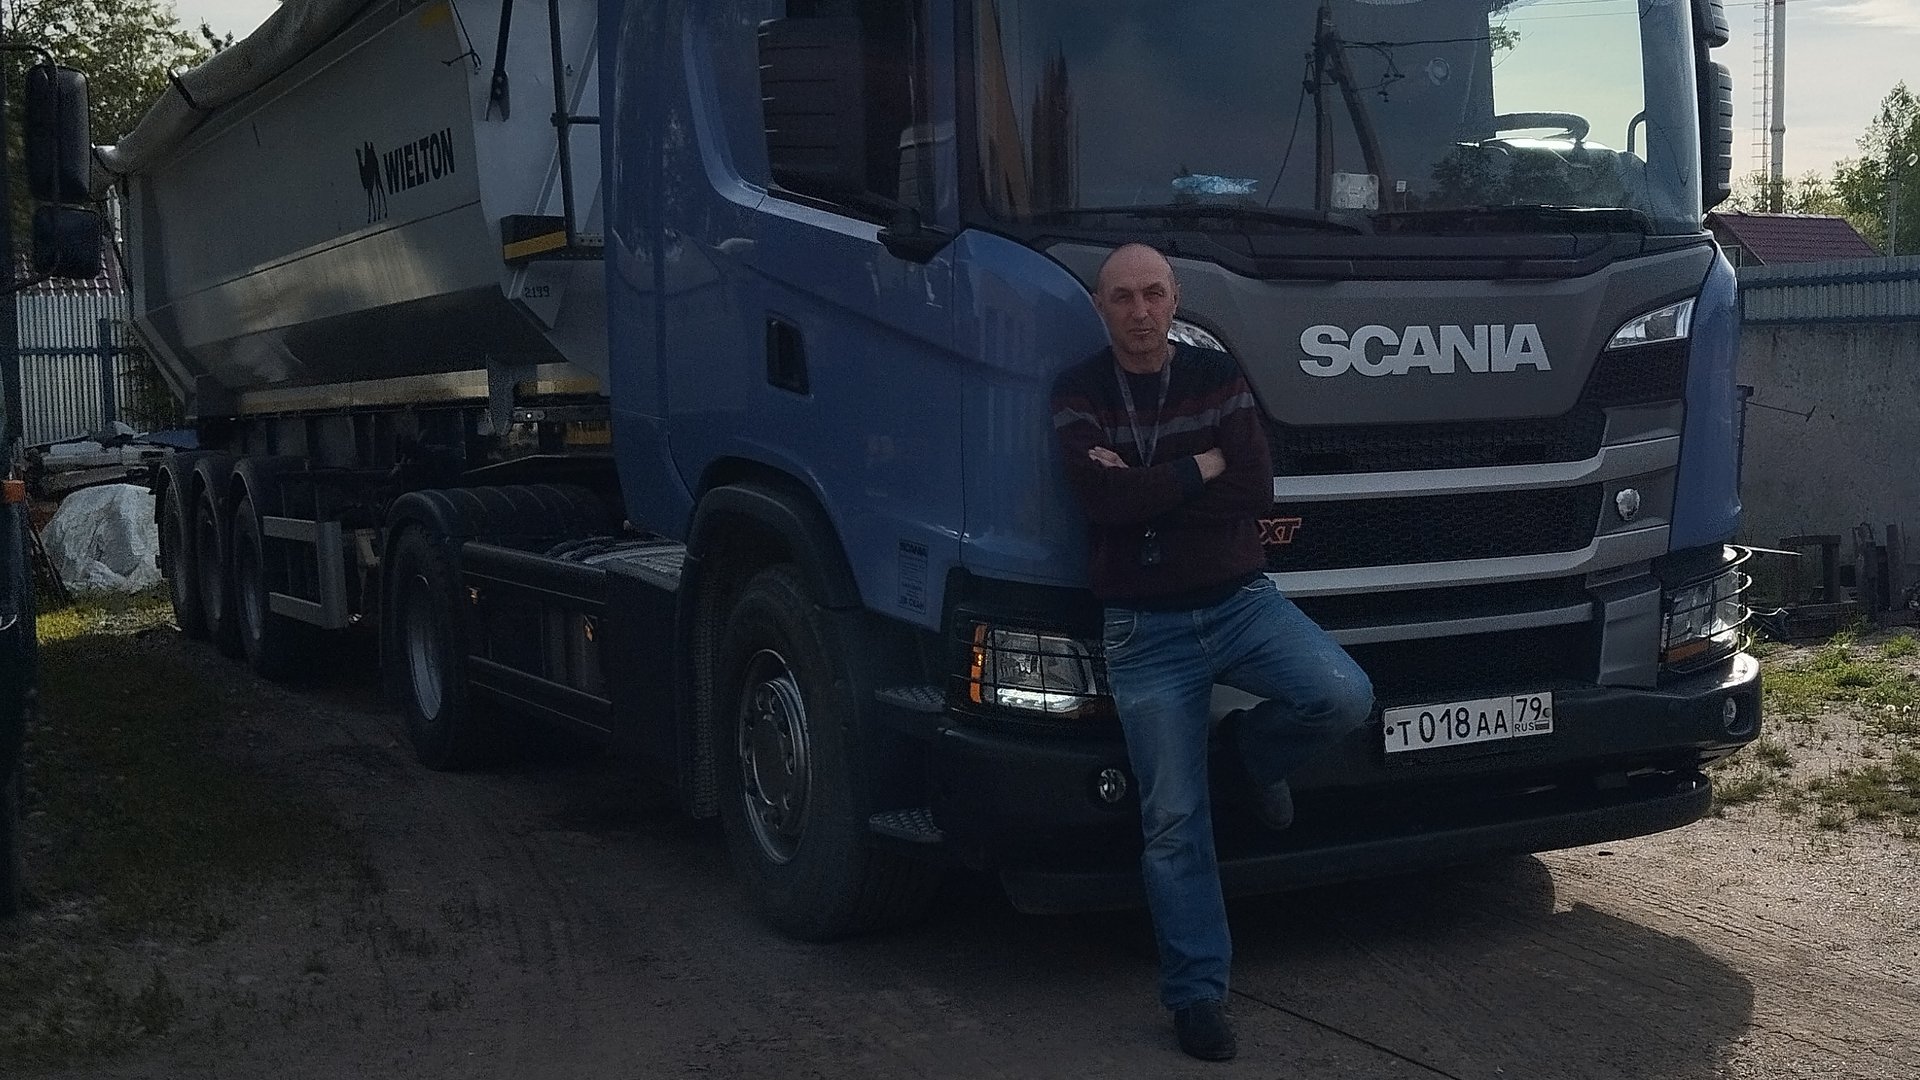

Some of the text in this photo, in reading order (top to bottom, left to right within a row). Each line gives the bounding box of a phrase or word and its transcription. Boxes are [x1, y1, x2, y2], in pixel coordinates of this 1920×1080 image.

[383, 127, 455, 195] WIELTON
[1299, 324, 1552, 377] SCANIA
[1257, 517, 1302, 545] XT
[1516, 697, 1542, 722] 79
[1514, 721, 1535, 732] RUS
